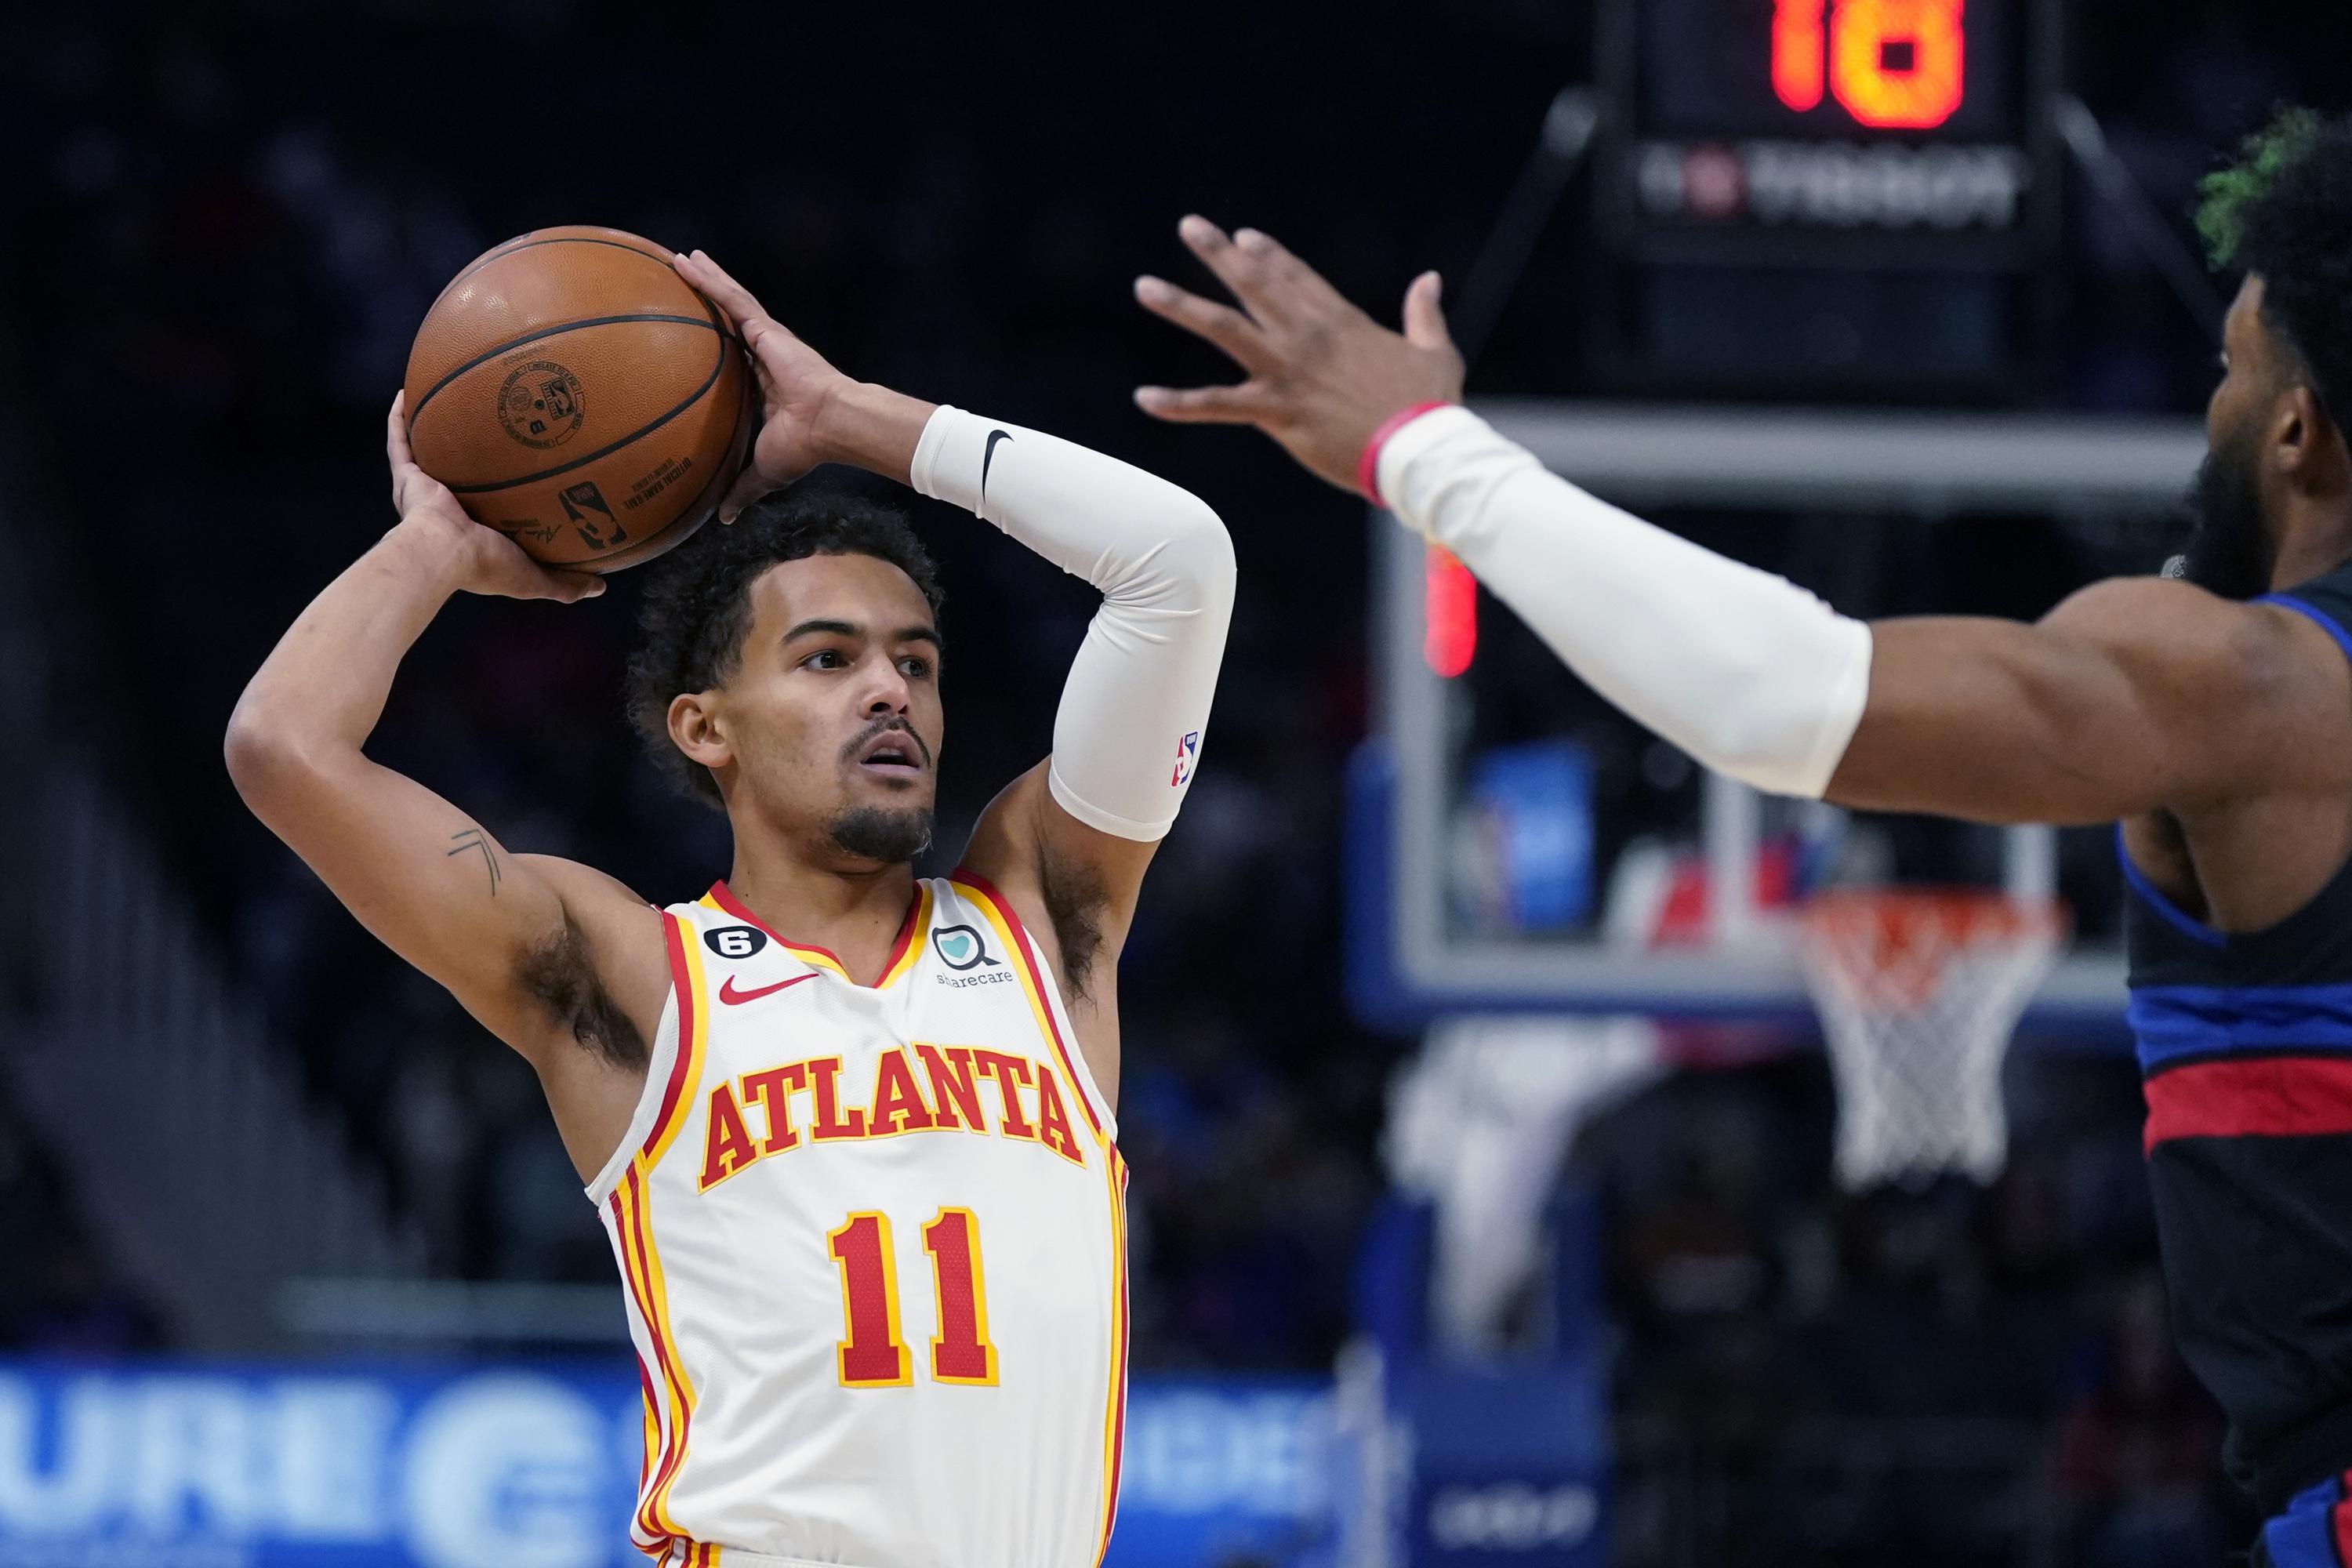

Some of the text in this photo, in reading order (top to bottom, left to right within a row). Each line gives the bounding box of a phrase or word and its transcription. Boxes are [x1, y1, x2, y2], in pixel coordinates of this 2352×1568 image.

[717, 930, 753, 956] 6
[937, 971, 1013, 989] sharecare
[697, 1040, 1087, 1195] ATLANTA
[827, 1206, 1000, 1387] 11
